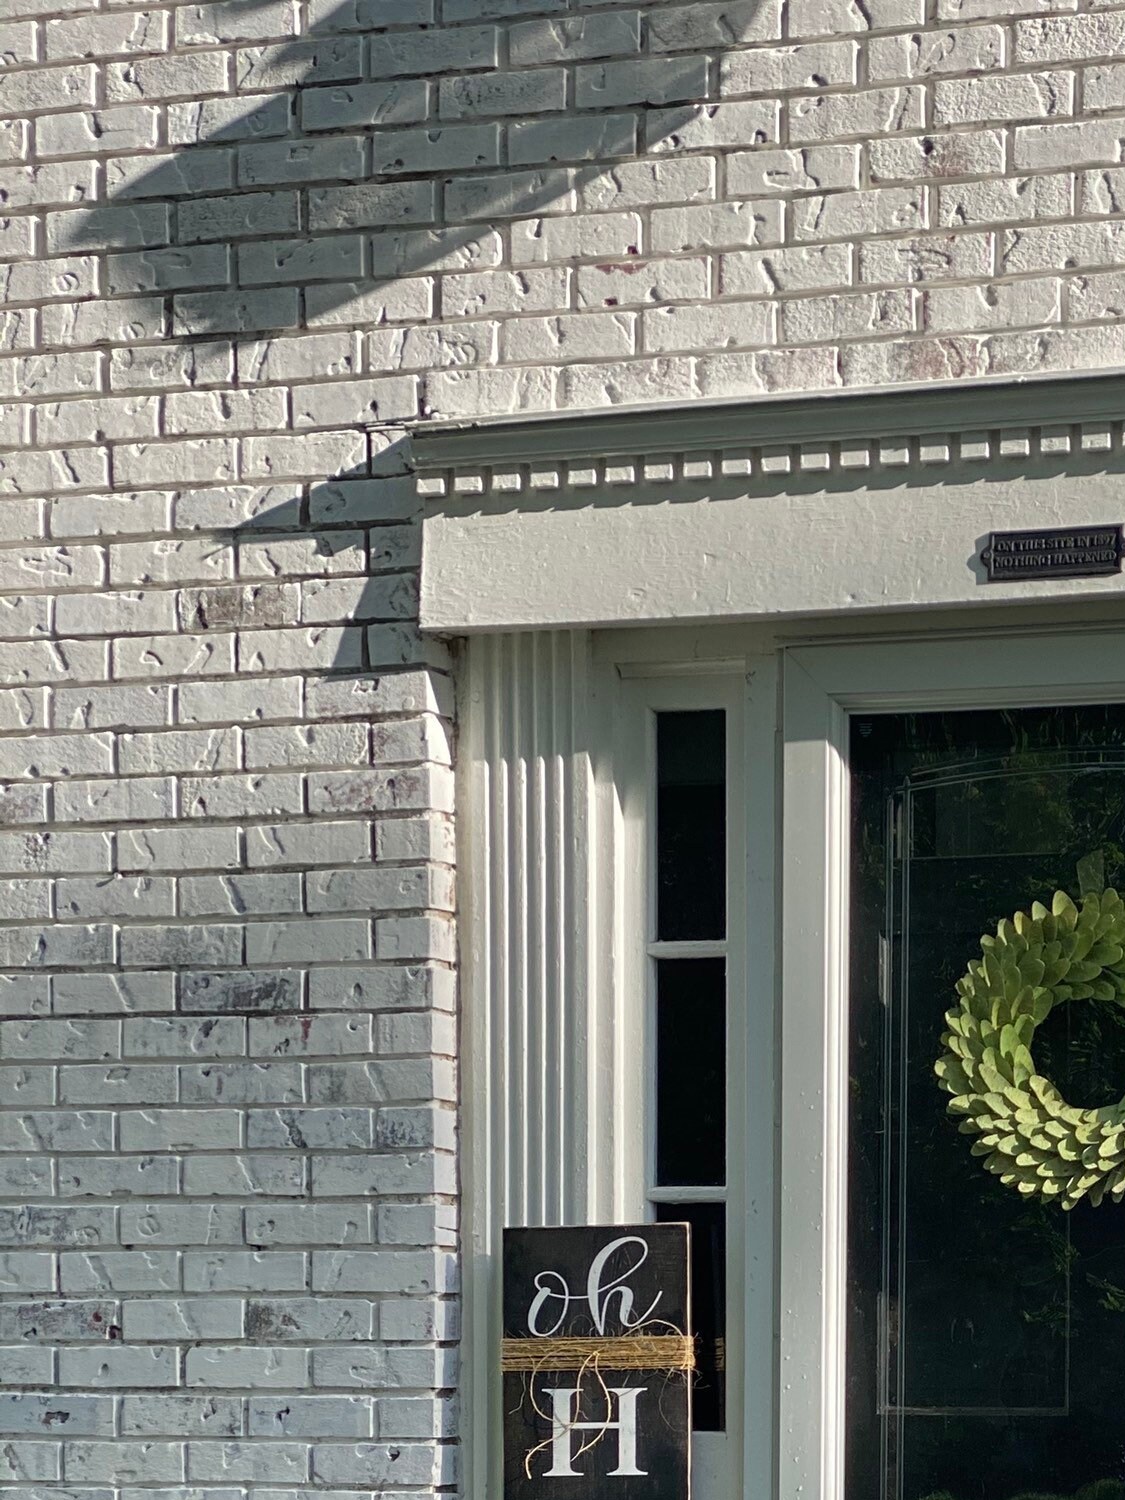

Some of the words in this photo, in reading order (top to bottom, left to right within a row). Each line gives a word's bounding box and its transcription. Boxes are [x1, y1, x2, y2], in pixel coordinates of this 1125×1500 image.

[997, 540, 1015, 552] ON
[1077, 536, 1090, 547] IN
[995, 554, 1051, 568] NOTHING
[1054, 550, 1117, 564] HAPPENED
[527, 1235, 663, 1337] oh
